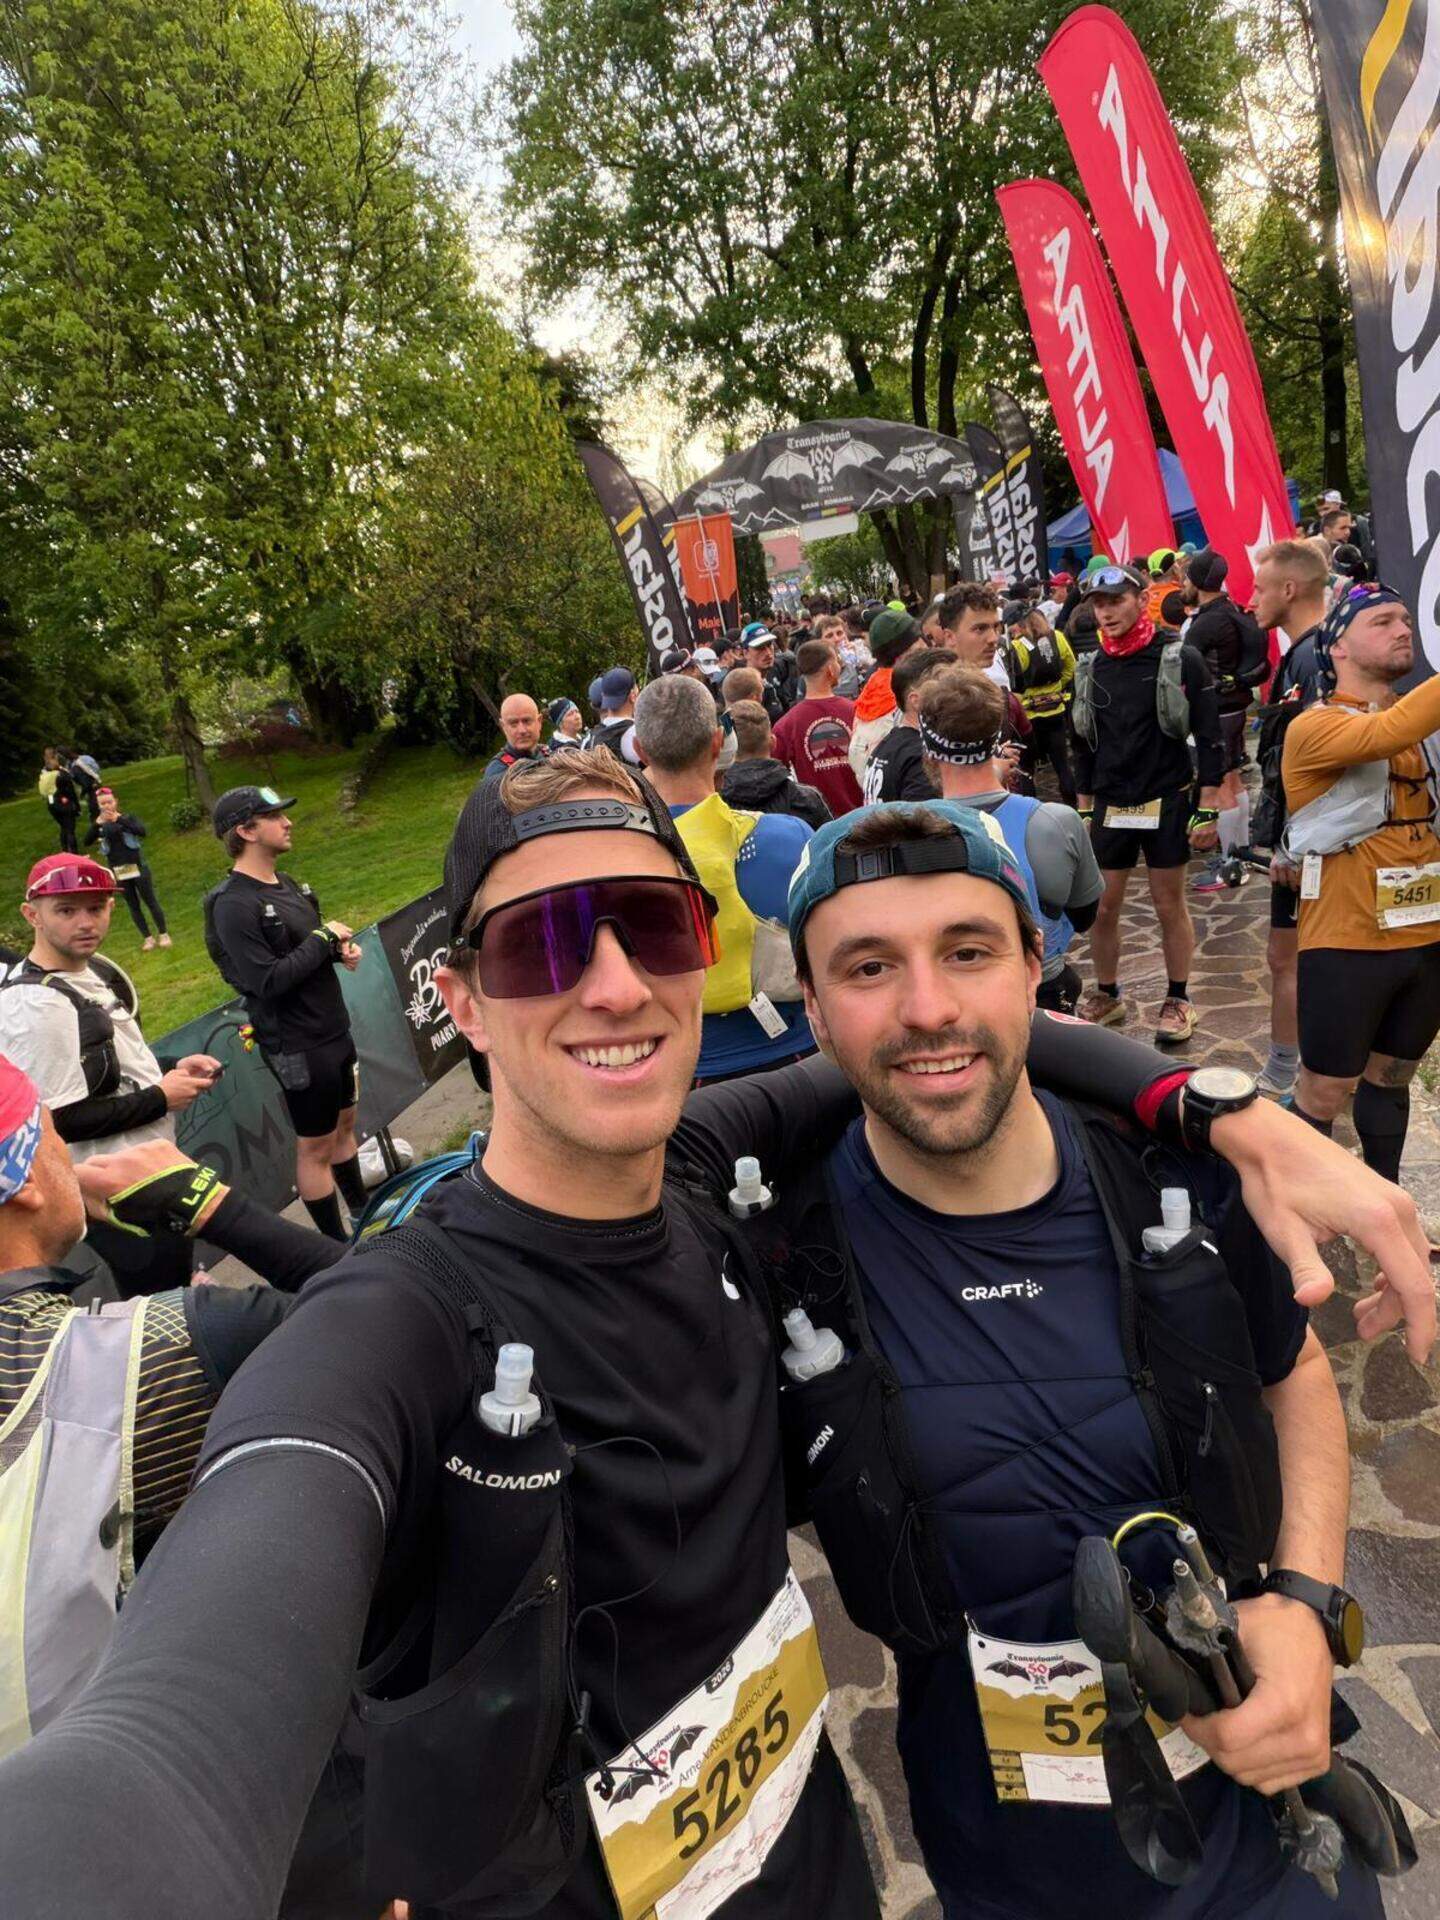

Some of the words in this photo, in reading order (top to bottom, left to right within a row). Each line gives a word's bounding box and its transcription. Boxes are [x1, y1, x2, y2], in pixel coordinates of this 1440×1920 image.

[786, 428, 851, 450] Transylvania
[808, 446, 834, 464] 100
[1392, 884, 1432, 906] 5451
[181, 1166, 217, 1206] LEKI
[961, 1282, 1024, 1301] CRAFT
[445, 1455, 562, 1491] SALOMON
[1007, 1652, 1065, 1662] Transylvania
[710, 1661, 733, 1689] 2026
[1027, 1663, 1048, 1676] 50
[672, 1689, 790, 1861] 5285
[677, 1763, 702, 1786] Arne
